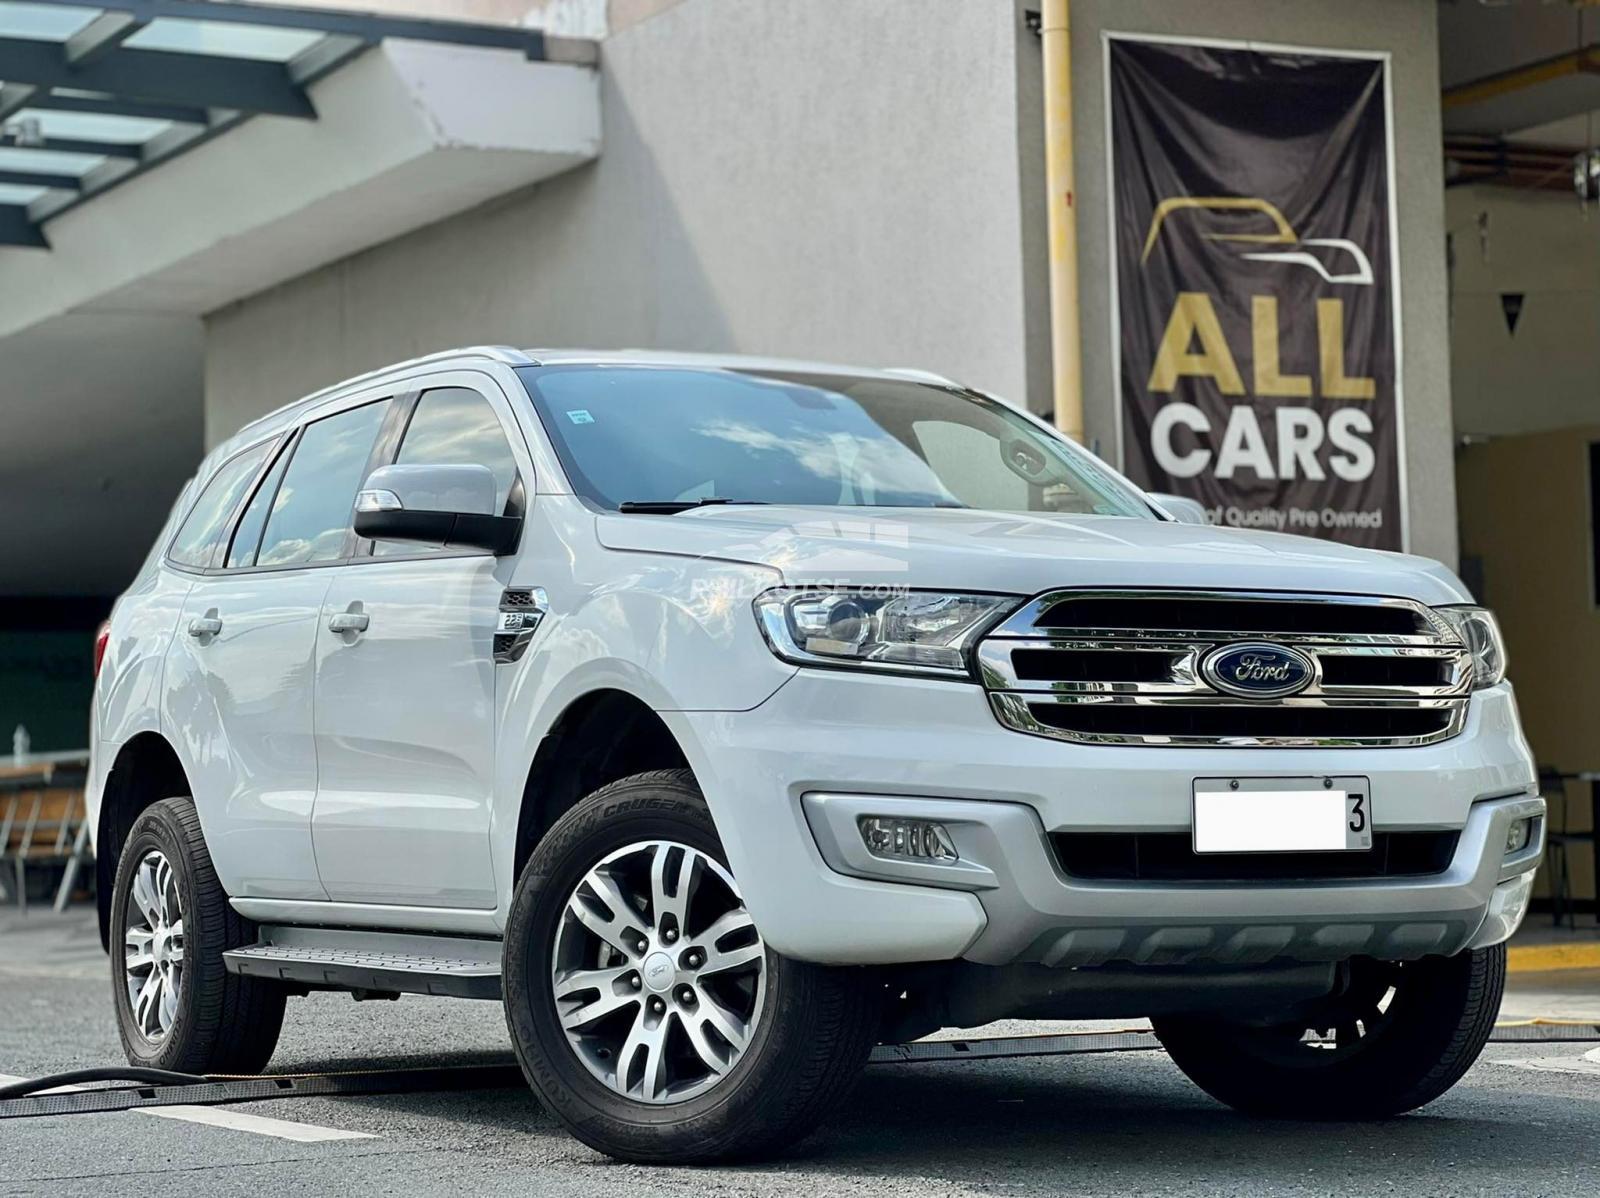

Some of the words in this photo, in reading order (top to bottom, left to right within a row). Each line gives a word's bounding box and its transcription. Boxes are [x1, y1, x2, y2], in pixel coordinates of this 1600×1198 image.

[1147, 292, 1376, 399] ALL
[1150, 402, 1376, 481] CARS
[1225, 506, 1286, 530] Quality
[1289, 507, 1319, 528] Pre
[1321, 507, 1383, 528] Owned
[1234, 653, 1290, 681] Ford
